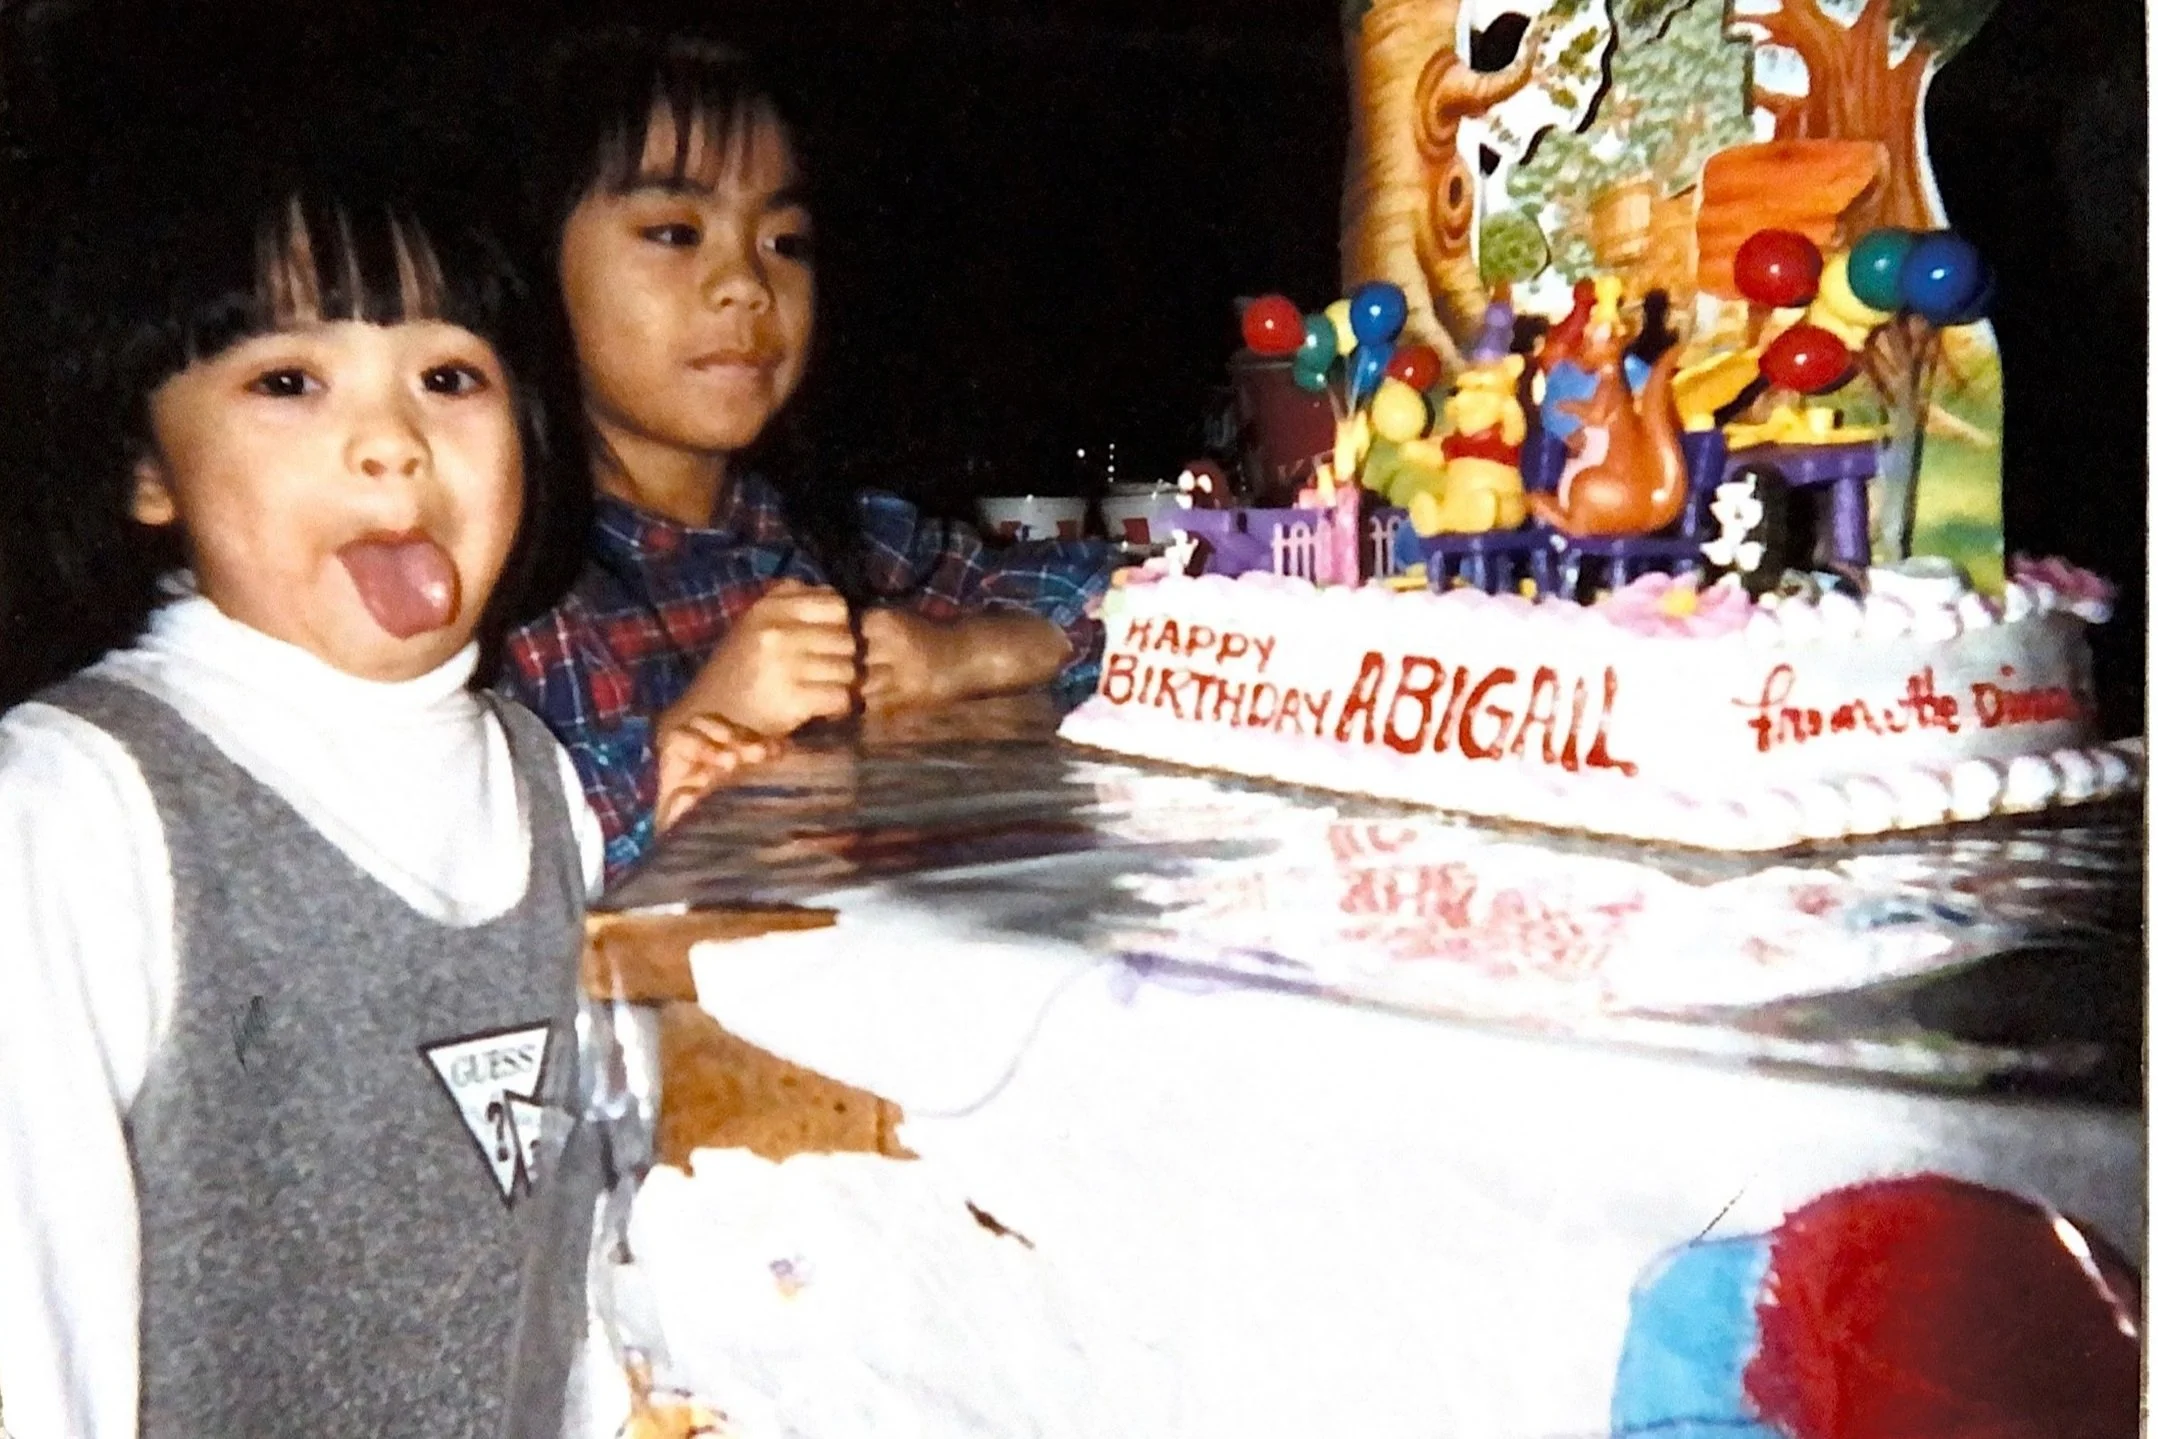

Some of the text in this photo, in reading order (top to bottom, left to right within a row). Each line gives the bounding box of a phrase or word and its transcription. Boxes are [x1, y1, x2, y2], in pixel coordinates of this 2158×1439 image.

[1127, 617, 1276, 672] HAPPY
[1101, 651, 1638, 777] BIRTHDAY ABIGAIL
[451, 1043, 537, 1087] GUESS
